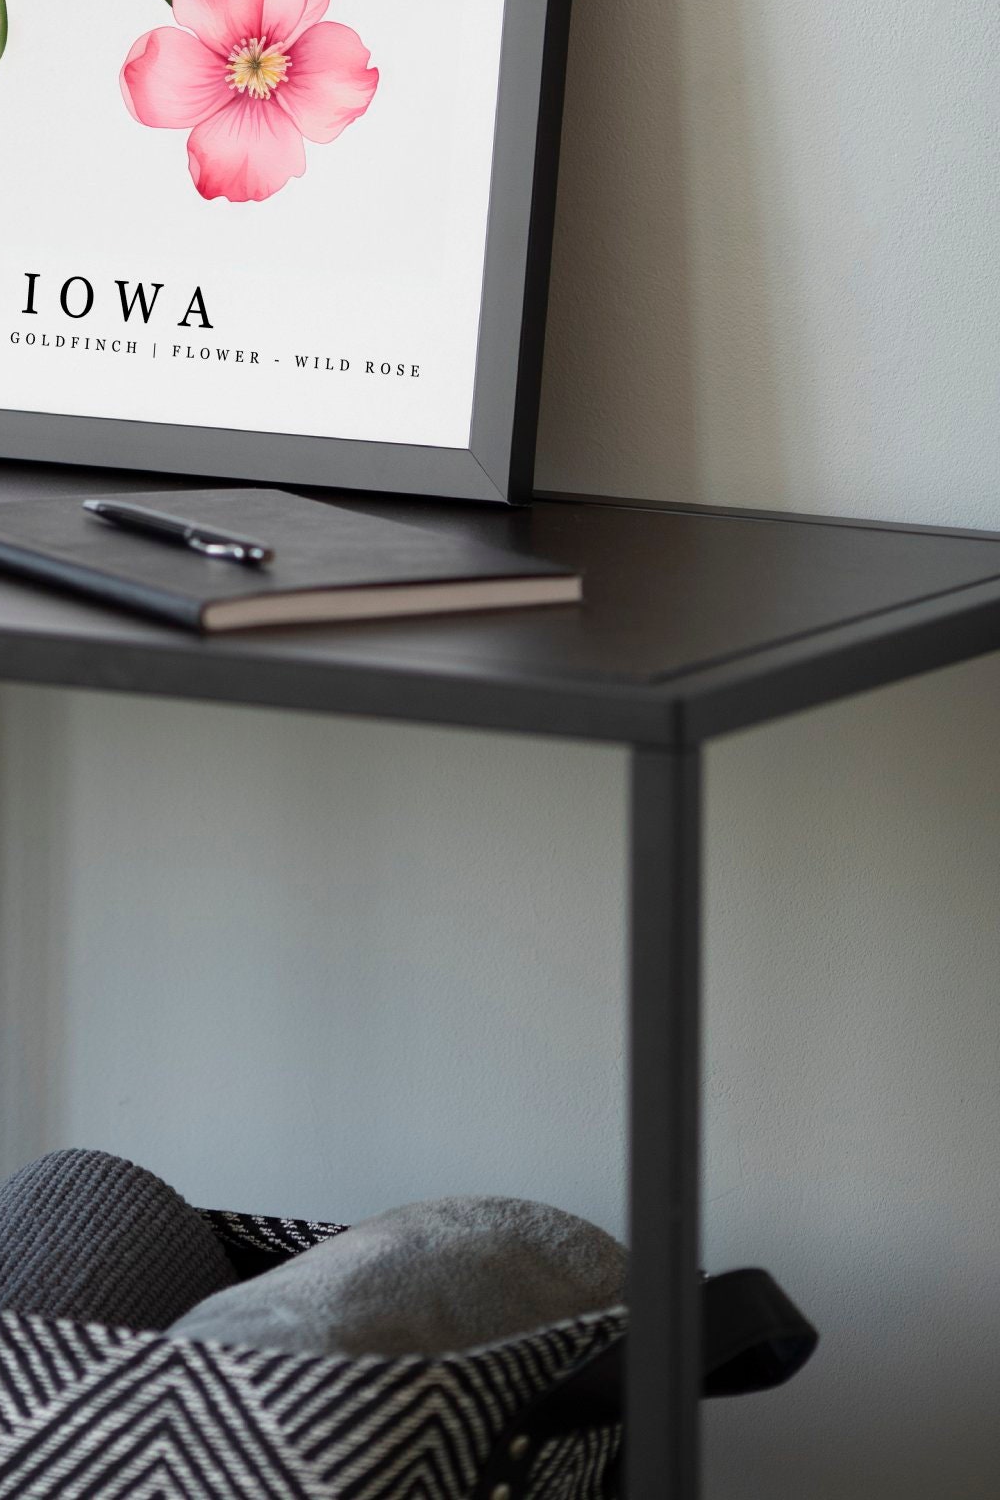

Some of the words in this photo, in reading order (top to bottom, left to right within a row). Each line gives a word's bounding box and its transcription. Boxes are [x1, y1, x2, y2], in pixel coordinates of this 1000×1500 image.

[21, 272, 214, 329] IOWA
[10, 331, 137, 354] GOLDFINCH
[172, 344, 260, 364] FLOWER
[294, 355, 350, 372] WILD
[365, 361, 421, 378] ROSE
